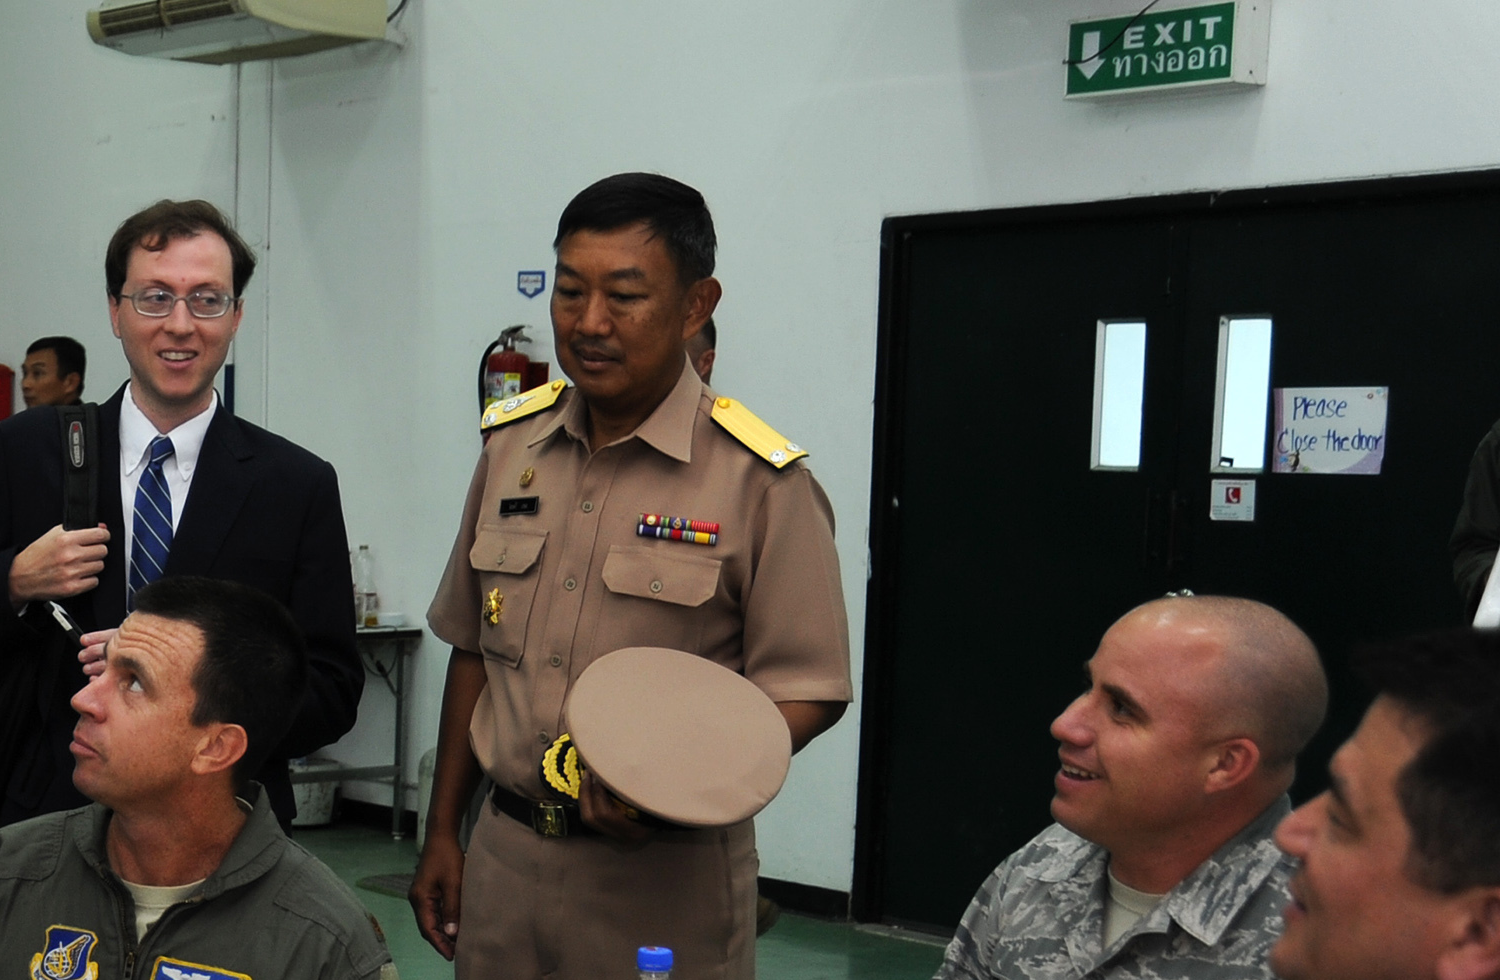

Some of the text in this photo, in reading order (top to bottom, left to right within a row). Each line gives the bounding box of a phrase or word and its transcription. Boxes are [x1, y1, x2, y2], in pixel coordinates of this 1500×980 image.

[1122, 16, 1222, 50] EXIT
[1112, 45, 1228, 79] ทางออก
[1293, 396, 1348, 421] Please
[1277, 427, 1383, 454] Close the door
